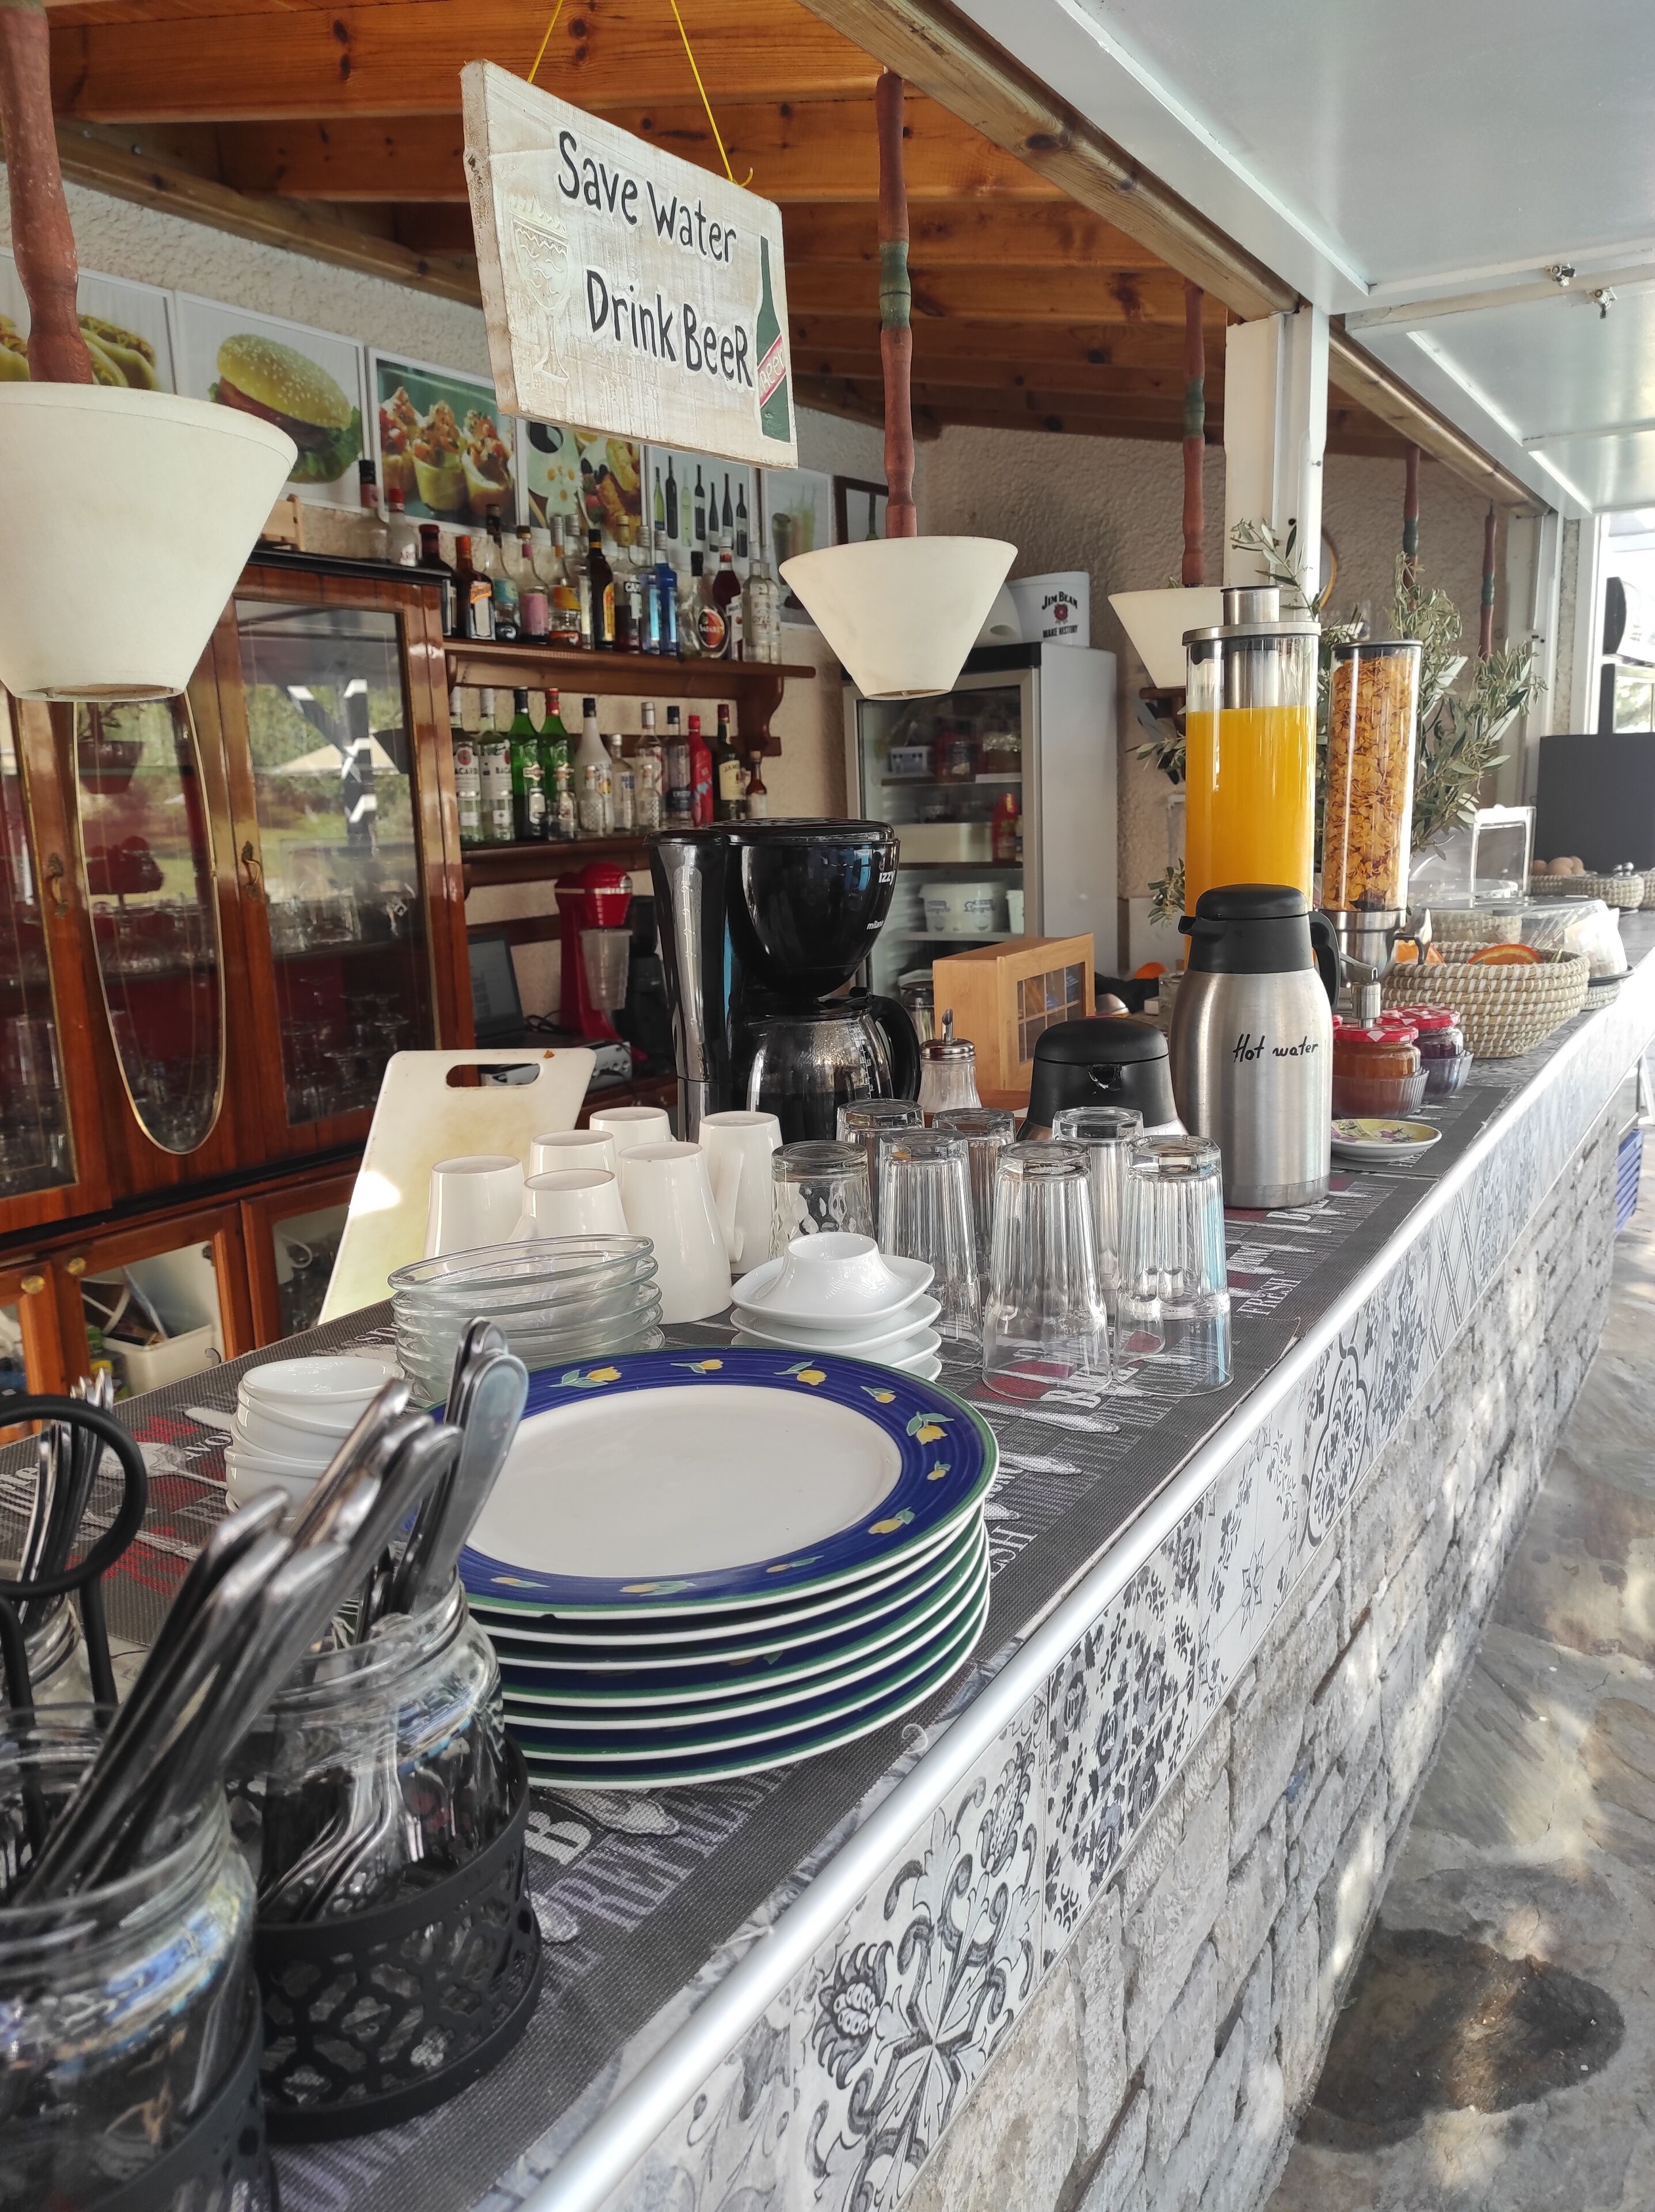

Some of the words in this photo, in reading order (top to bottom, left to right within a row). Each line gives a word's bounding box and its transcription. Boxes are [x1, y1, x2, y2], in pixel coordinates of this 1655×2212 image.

[558, 130, 638, 225] Save
[647, 180, 737, 263] Water
[587, 269, 676, 362] Drink
[1041, 594, 1058, 610] JIM
[1059, 590, 1078, 609] BEAM
[878, 870, 896, 886] izzy
[1232, 1033, 1266, 1062] Hot
[1272, 1036, 1319, 1056] water
